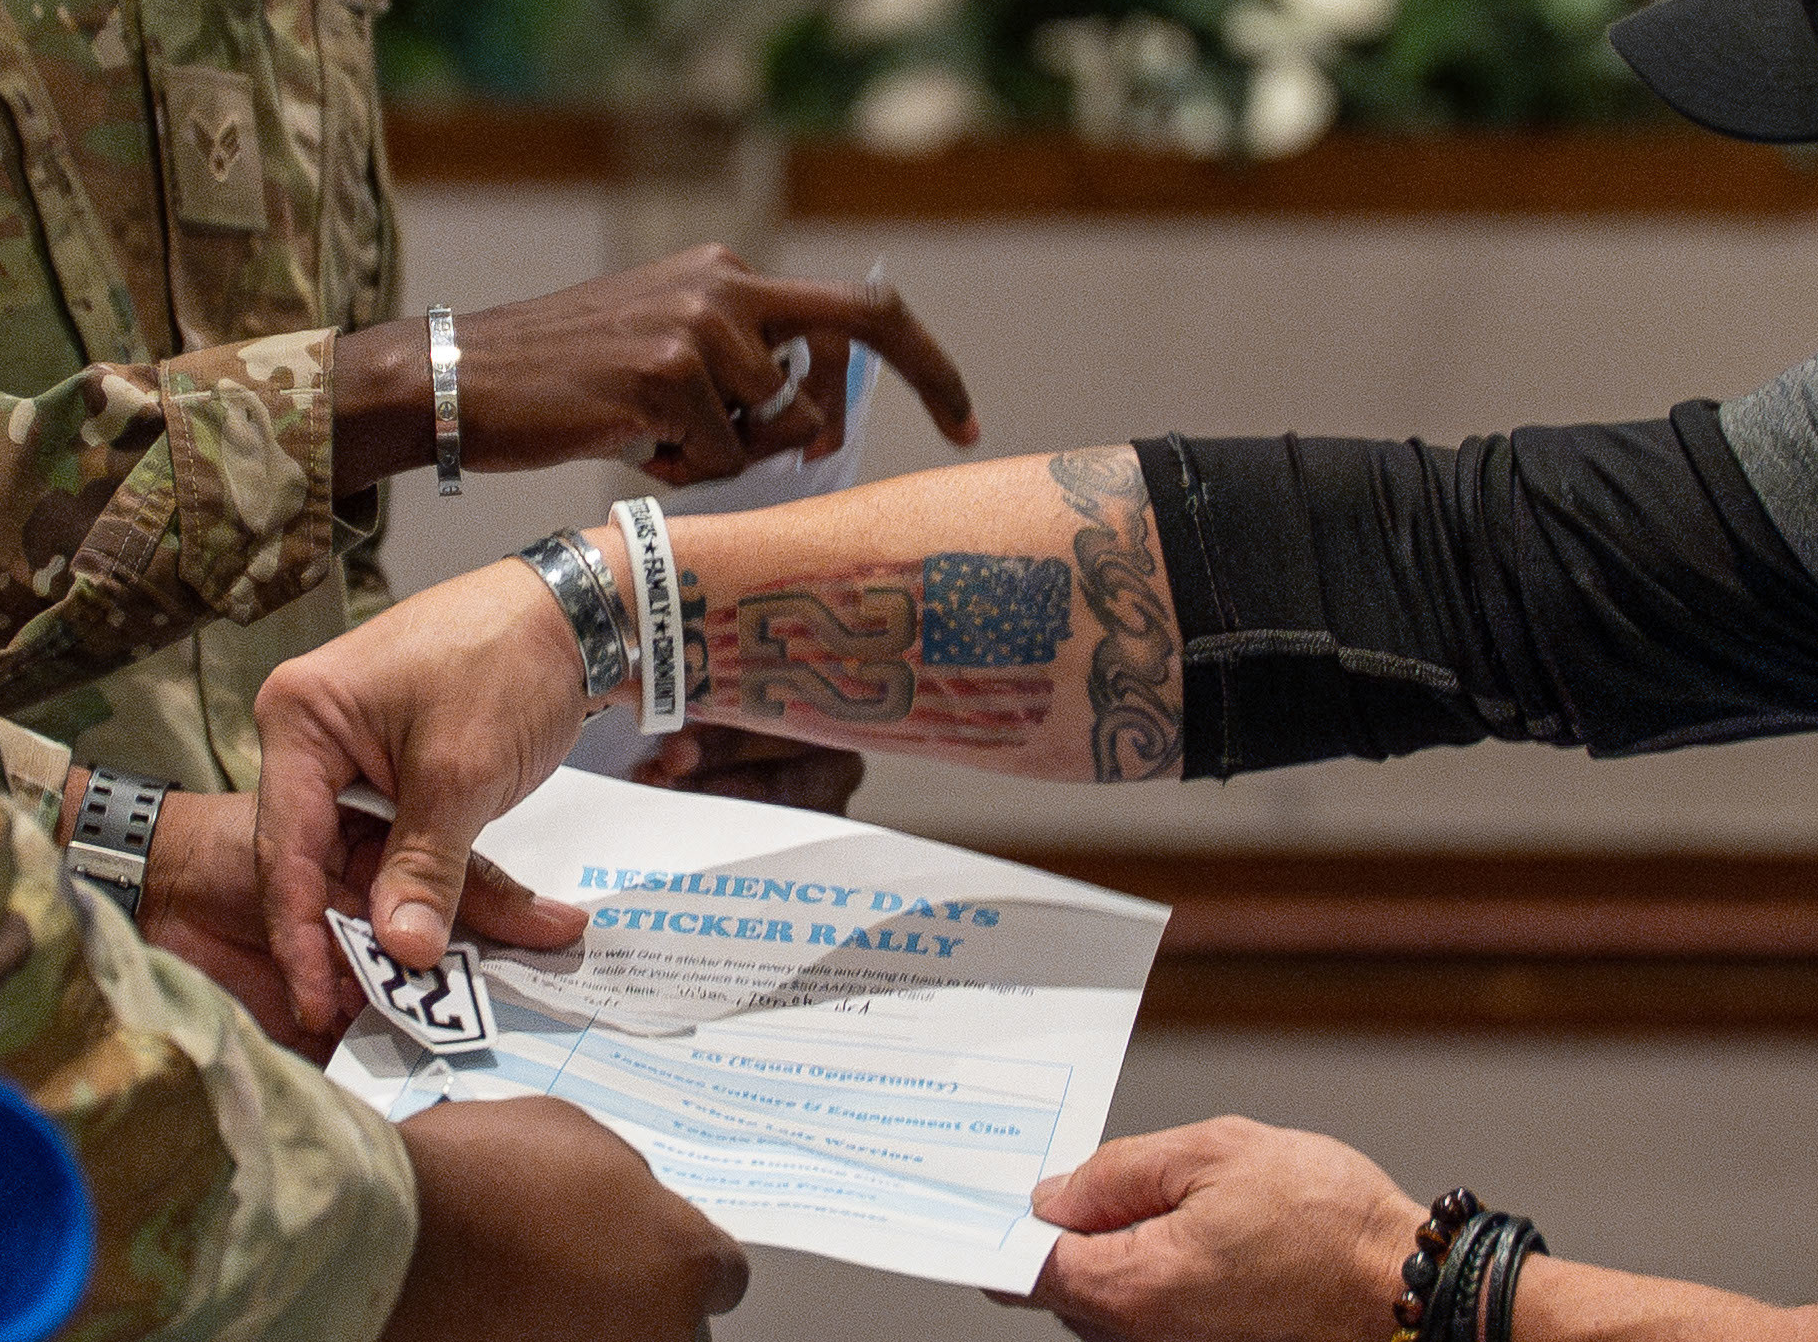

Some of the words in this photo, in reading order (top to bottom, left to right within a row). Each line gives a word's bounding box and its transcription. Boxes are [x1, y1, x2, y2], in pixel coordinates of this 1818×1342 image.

[643, 558, 671, 615] FAMILY
[578, 866, 861, 907] RESILIENCY
[870, 890, 1001, 928] DAYS
[592, 908, 794, 944] STICKER
[808, 923, 965, 958] RALLY
[728, 1055, 804, 1076] (Equal
[808, 1065, 959, 1094] Opportunity)
[827, 1104, 962, 1132] Engagement
[969, 1120, 1022, 1137] Club
